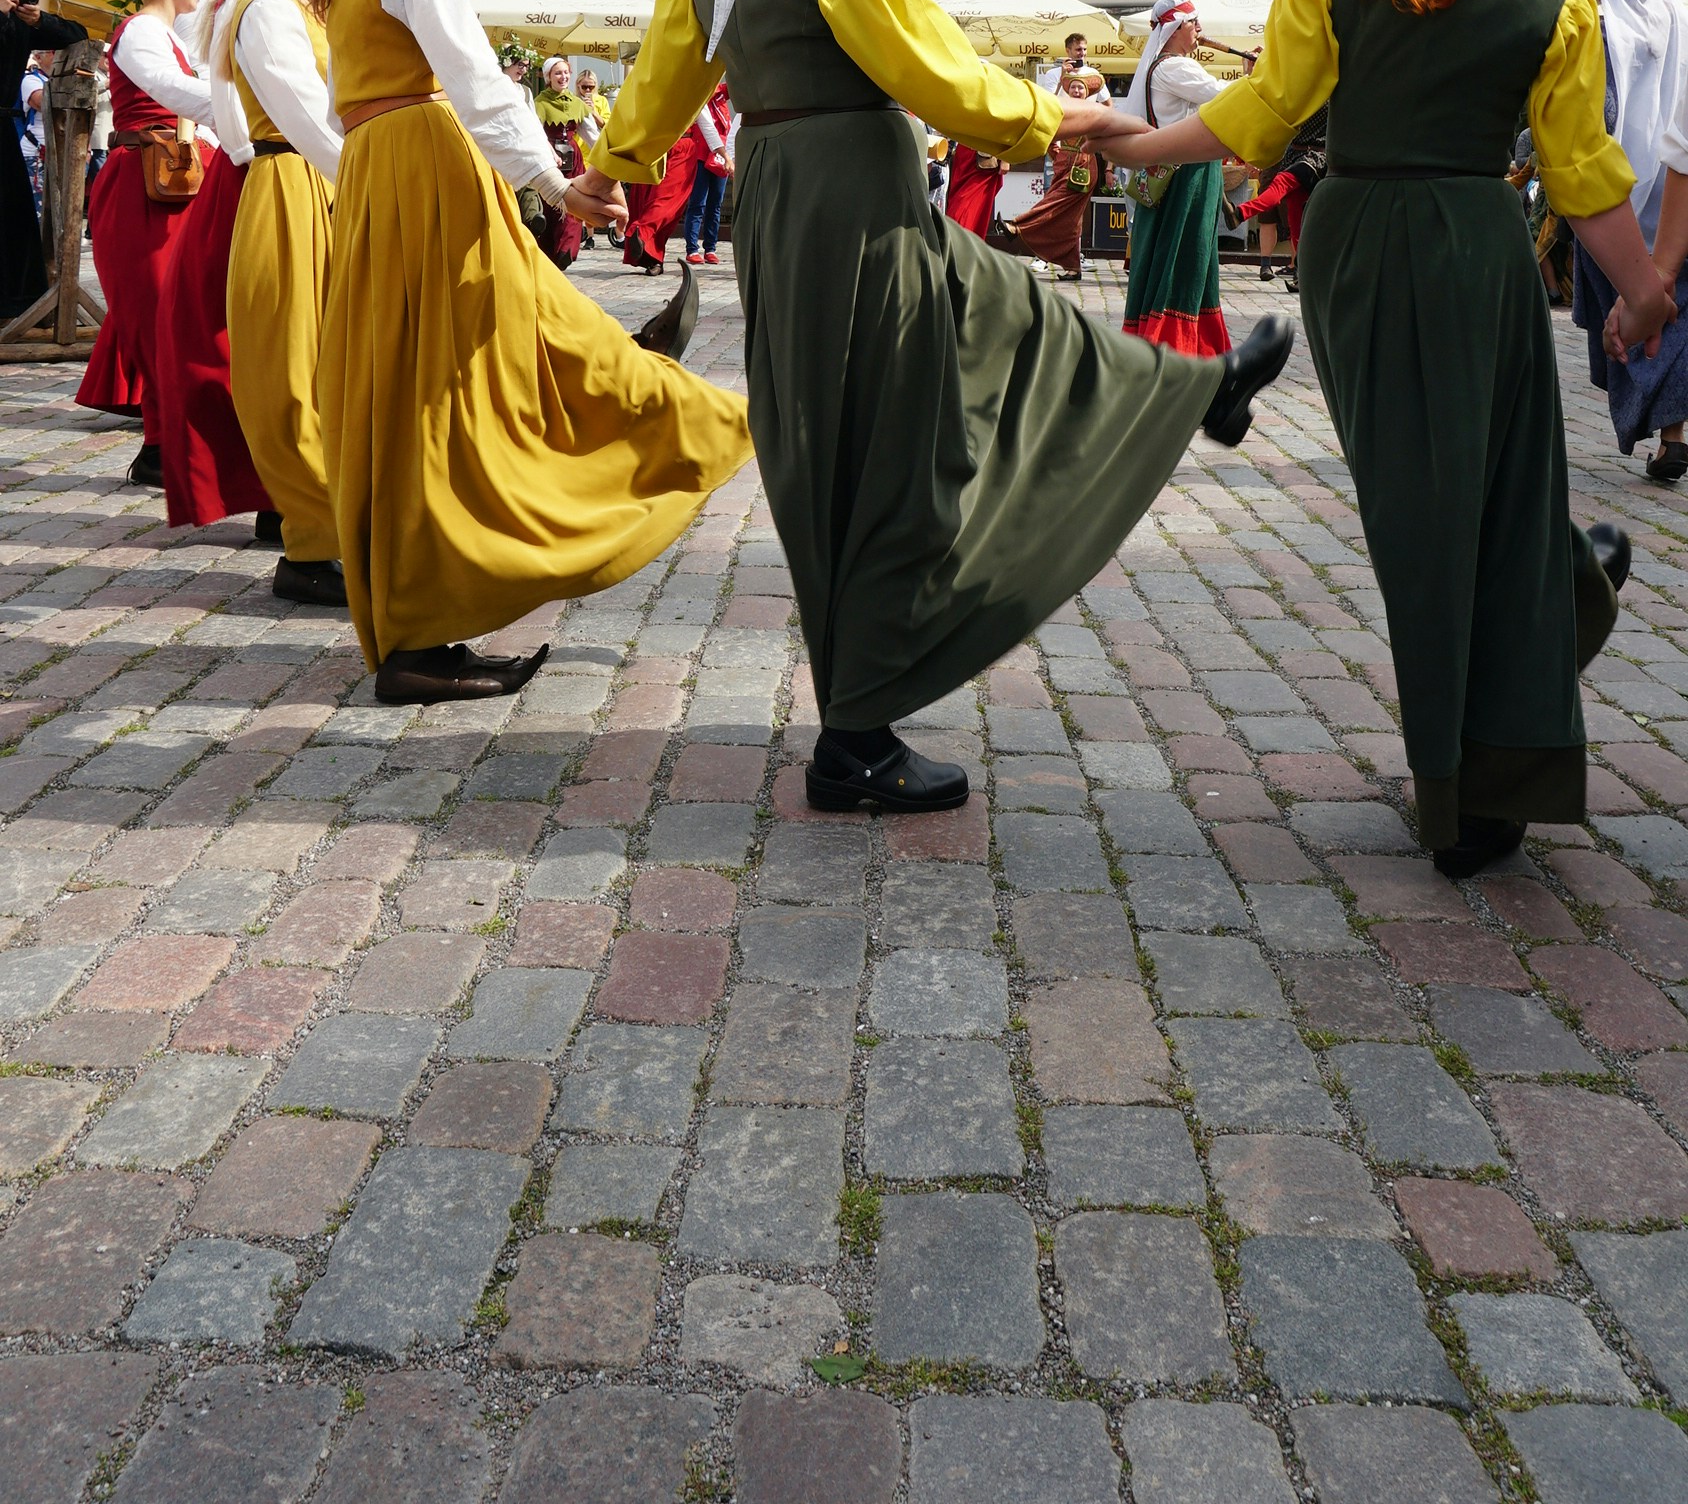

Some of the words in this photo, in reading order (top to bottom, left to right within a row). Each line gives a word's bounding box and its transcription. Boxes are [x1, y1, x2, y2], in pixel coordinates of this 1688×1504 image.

[525, 12, 557, 24] saku
[604, 14, 636, 27] saku
[1248, 23, 1264, 35] sa
